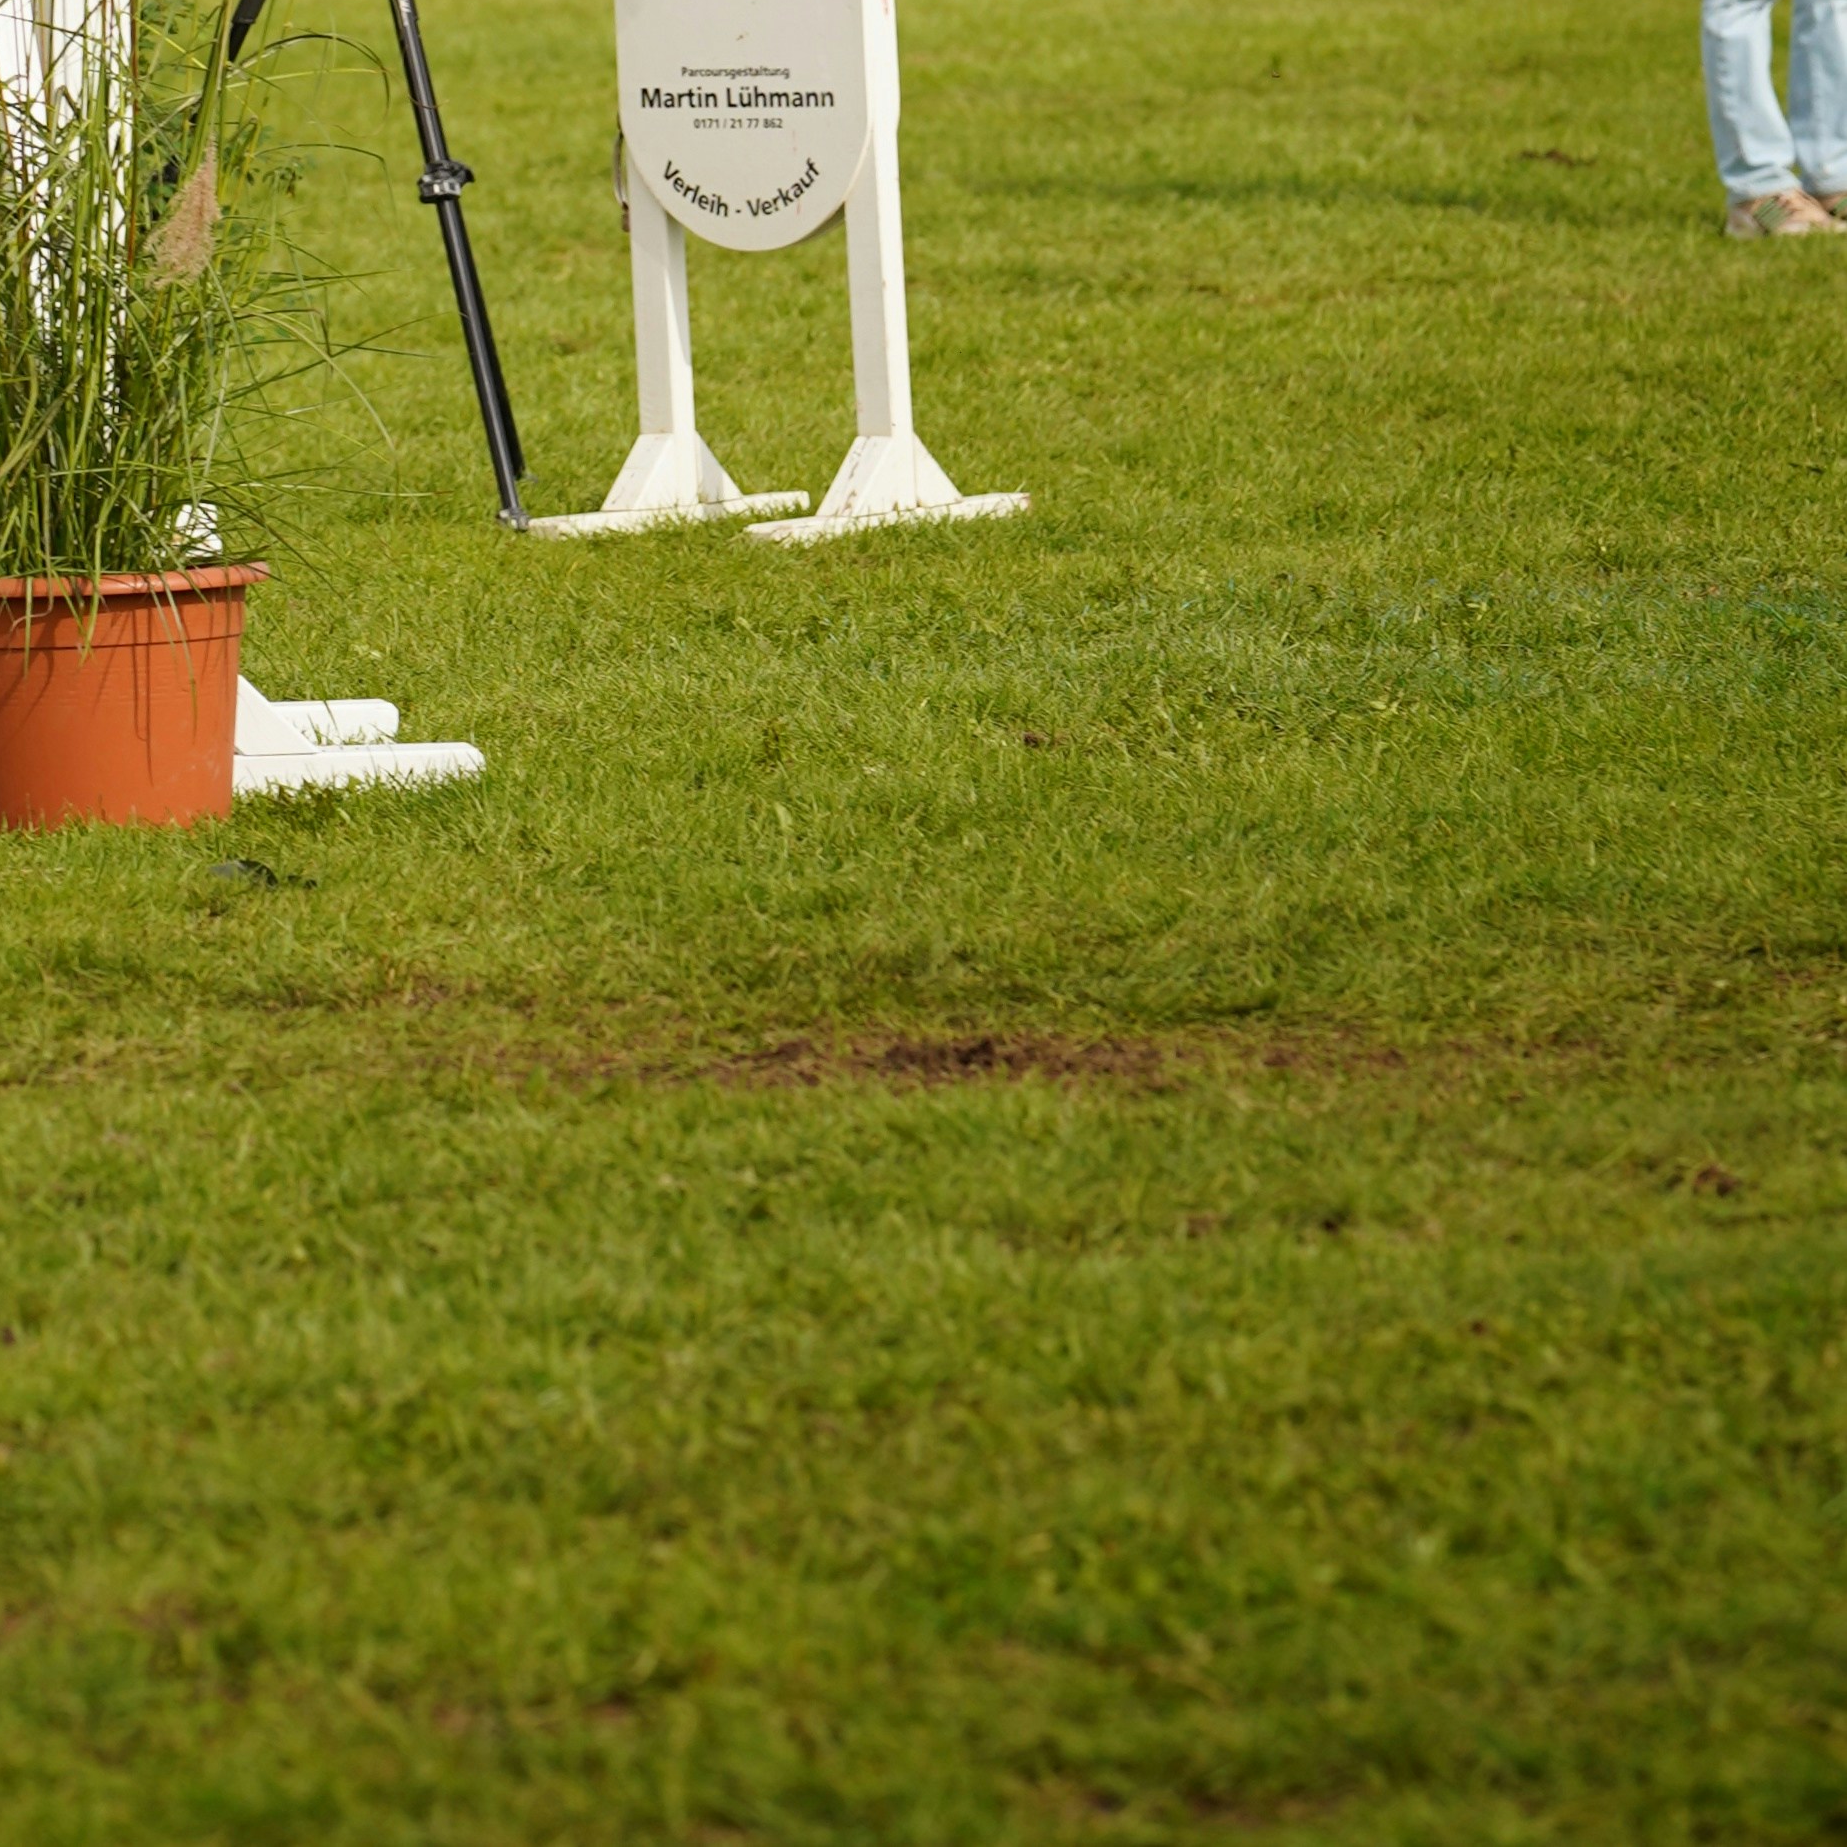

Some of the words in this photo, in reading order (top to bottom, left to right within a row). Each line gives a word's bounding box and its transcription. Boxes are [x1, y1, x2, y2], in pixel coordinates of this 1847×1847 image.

[681, 66, 790, 80] Parcoursgestaltung
[640, 86, 719, 108] Martin
[726, 86, 835, 108] Lühmann
[693, 118, 720, 129] 0171
[729, 118, 743, 129] 21
[747, 118, 760, 129] 77
[663, 160, 729, 218] Verleih
[746, 158, 821, 218] Verkauf
